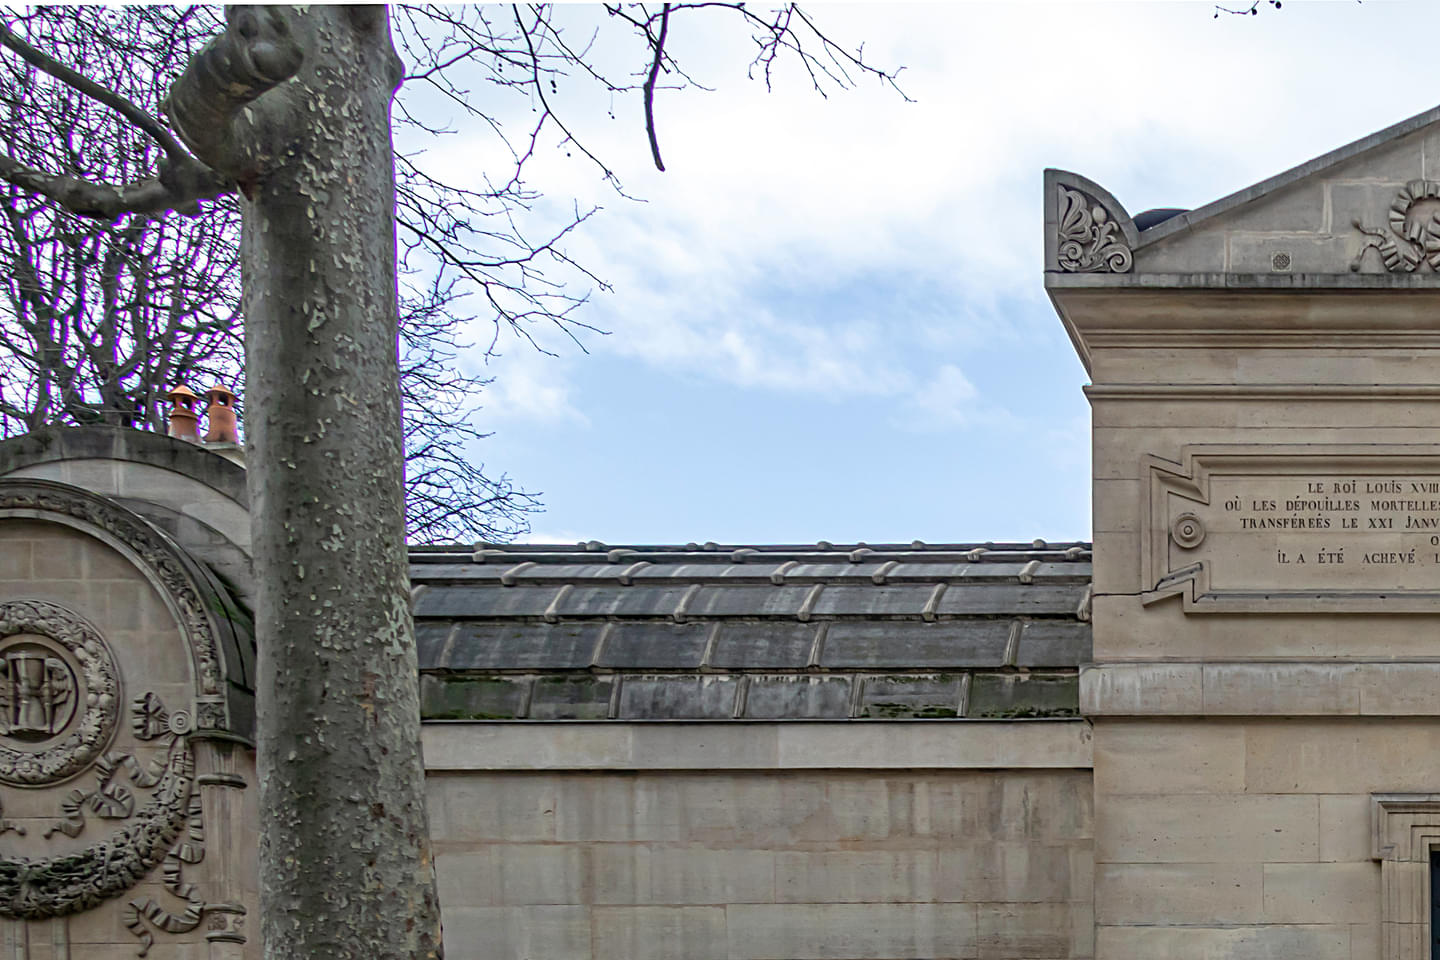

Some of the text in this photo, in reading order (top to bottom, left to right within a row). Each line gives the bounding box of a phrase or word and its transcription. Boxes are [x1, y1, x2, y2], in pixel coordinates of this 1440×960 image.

[1307, 482, 1325, 494] LE
[1366, 479, 1402, 494] LOUIS
[1410, 482, 1440, 494] XVIII
[1224, 495, 1242, 512] OÙ
[1252, 499, 1277, 512] LES
[1285, 495, 1361, 512] DÉPOUILLES
[1342, 517, 1359, 529] LE
[1368, 517, 1393, 529] XXI
[1296, 553, 1306, 565] A
[1317, 547, 1345, 565] ÉTÉ
[1362, 548, 1416, 565] ACHEVÉ
